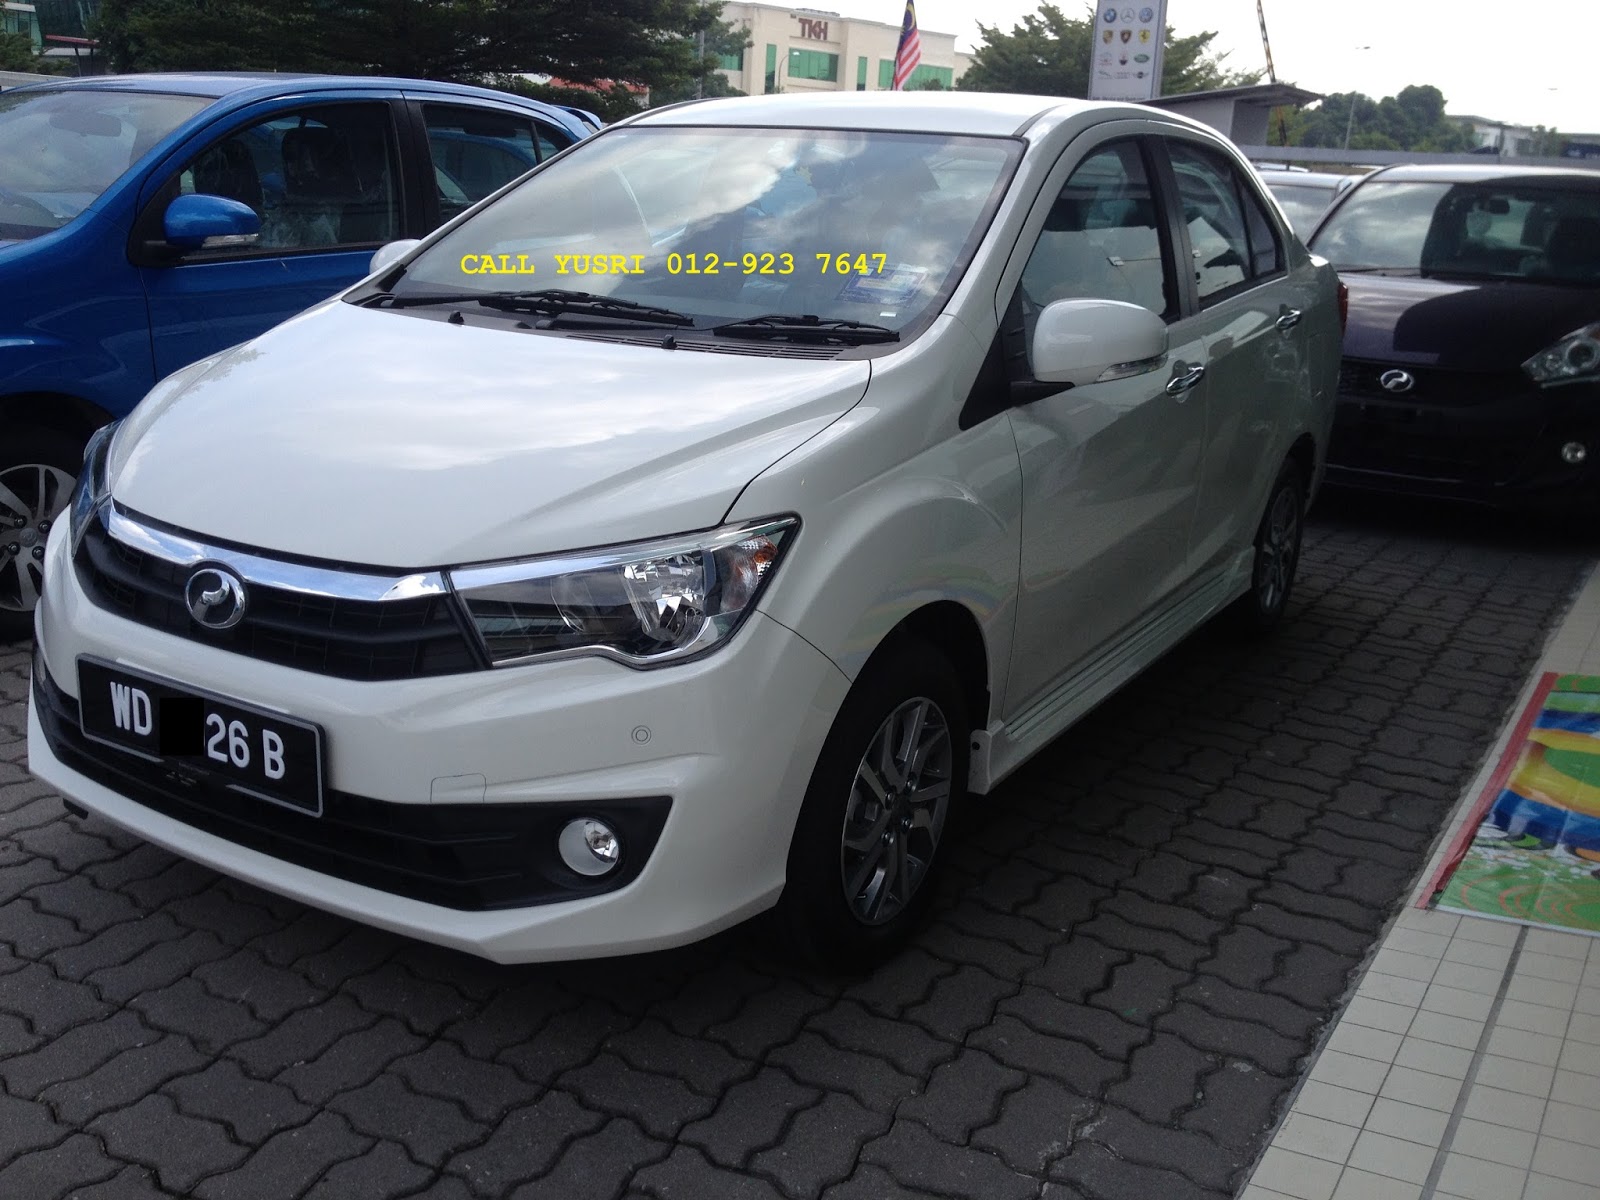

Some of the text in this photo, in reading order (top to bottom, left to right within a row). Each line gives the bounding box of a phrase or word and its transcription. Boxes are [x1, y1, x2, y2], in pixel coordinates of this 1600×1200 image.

[798, 17, 829, 41] TKH
[110, 681, 153, 736] WD
[262, 728, 286, 780] B
